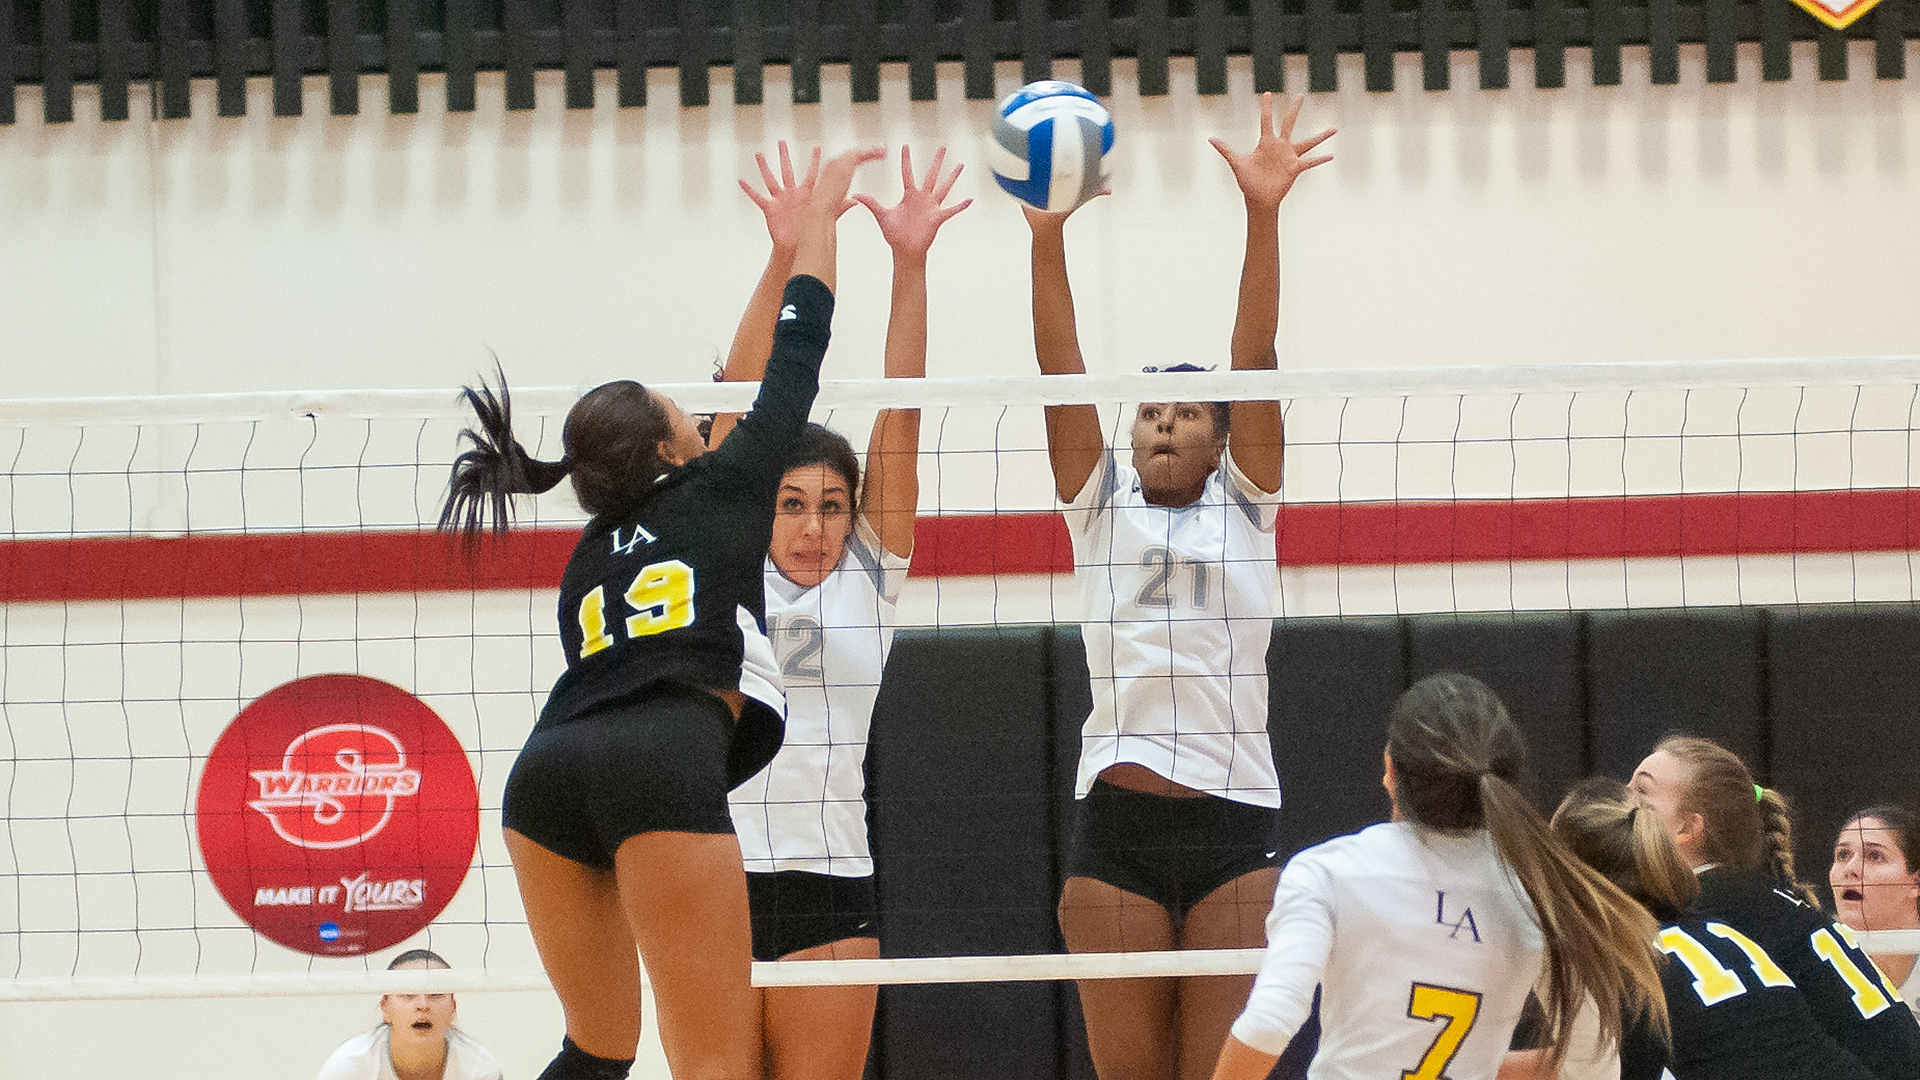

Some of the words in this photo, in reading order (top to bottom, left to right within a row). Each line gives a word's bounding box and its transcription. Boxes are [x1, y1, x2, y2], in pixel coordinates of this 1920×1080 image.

[610, 524, 657, 555] LA
[1135, 545, 1210, 610] 21
[579, 559, 695, 660] 19
[264, 774, 415, 794] WARRIORS
[254, 887, 314, 906] MAKE
[318, 885, 339, 904] IT
[340, 872, 425, 914] YOURS
[1436, 890, 1482, 943] LA
[1653, 922, 1796, 1007] 11
[1401, 981, 1483, 1080] 7
